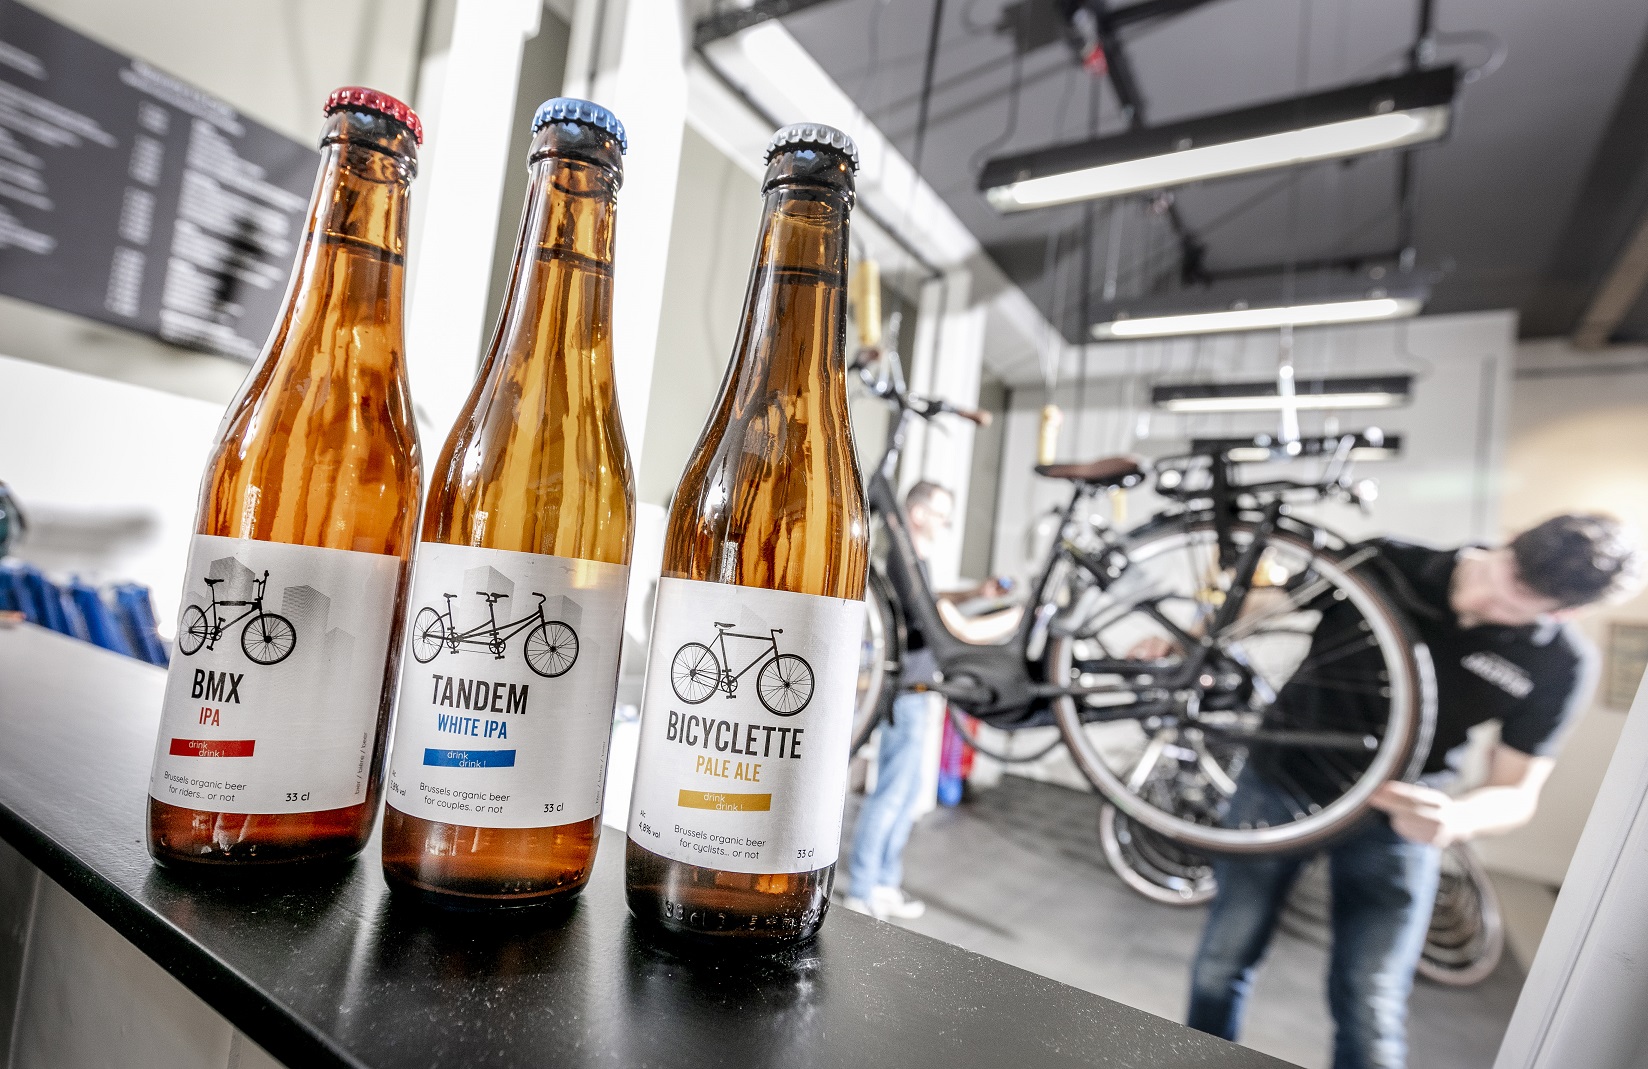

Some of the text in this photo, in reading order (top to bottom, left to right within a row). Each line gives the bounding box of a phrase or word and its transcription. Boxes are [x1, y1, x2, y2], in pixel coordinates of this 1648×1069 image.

[191, 668, 245, 704] BMX
[432, 673, 529, 715] TANDEM
[199, 707, 220, 726] IPA
[438, 713, 508, 739] WHITE IPA
[666, 710, 805, 759] BICYCLETTE
[188, 741, 208, 750] drink
[198, 749, 220, 757] drink
[447, 750, 469, 760] drink
[458, 760, 481, 768] drink
[695, 755, 762, 783] PALE ALE
[164, 770, 189, 784] Brussels
[190, 778, 222, 789] organic
[224, 781, 247, 791] beer
[168, 784, 178, 794] for
[219, 794, 236, 802] not
[285, 792, 310, 802] 33 cl
[419, 782, 511, 802] Brussels organic beer
[703, 793, 726, 803] drink
[424, 795, 435, 805] for
[475, 805, 486, 813] or
[487, 805, 503, 814] not
[543, 802, 564, 813] 33 cl
[715, 803, 739, 812] drink
[652, 830, 661, 839] vol
[674, 824, 767, 848] Brussels organic beer
[679, 838, 692, 848] for
[732, 850, 742, 858] or
[744, 850, 760, 859] not
[796, 847, 815, 859] 33 cl
